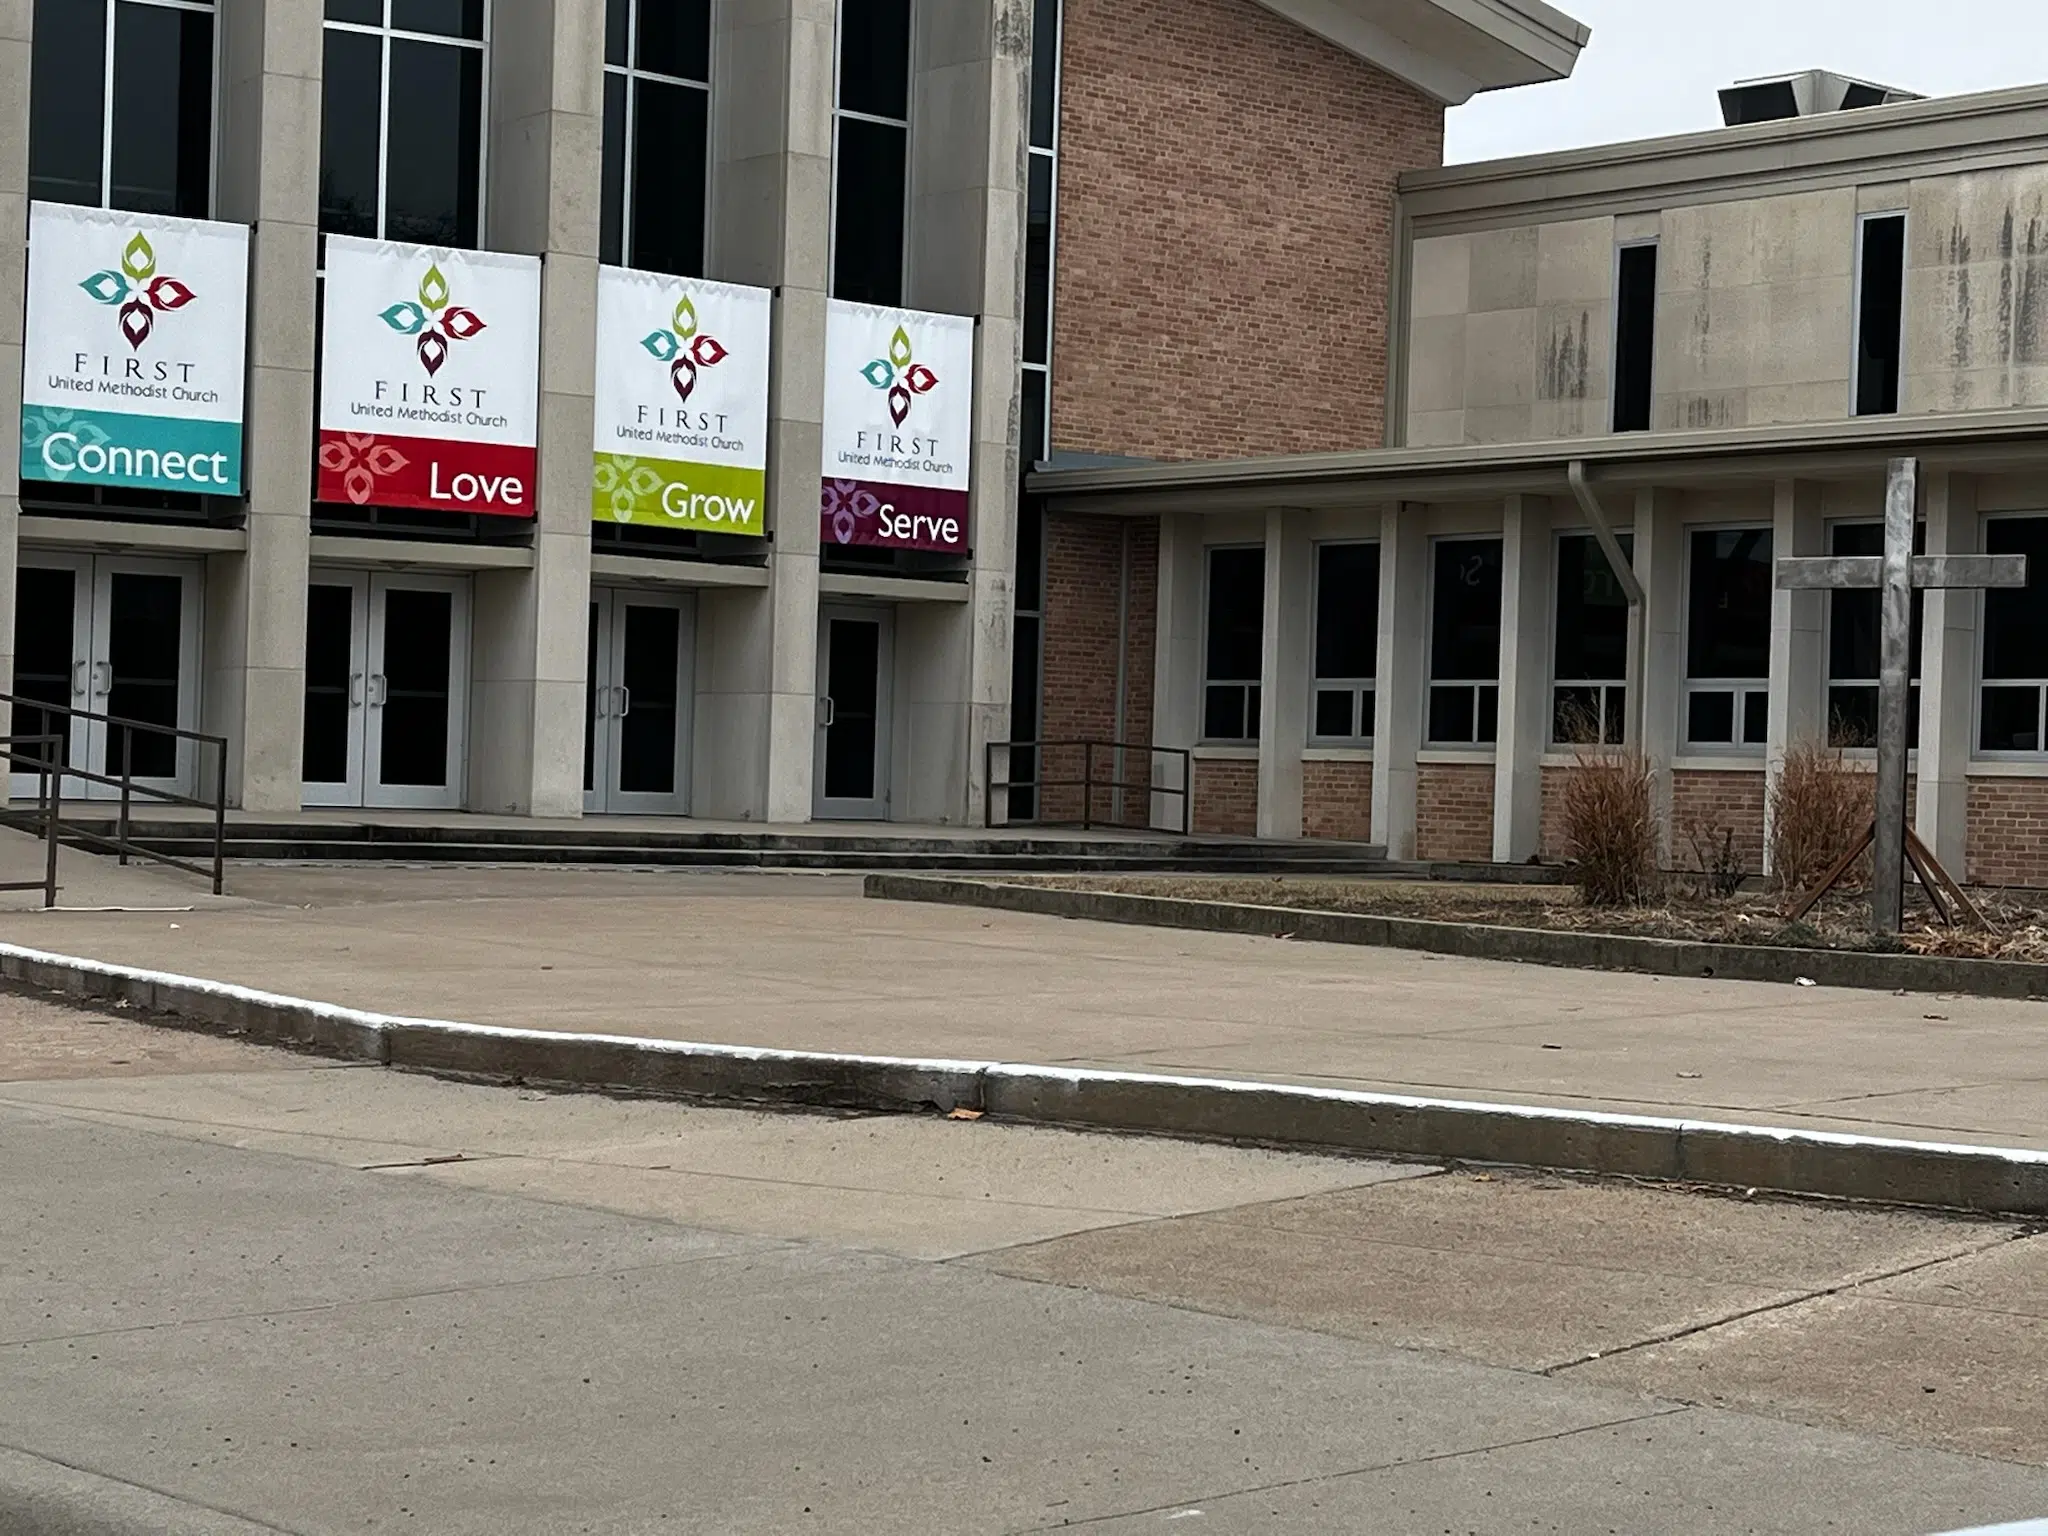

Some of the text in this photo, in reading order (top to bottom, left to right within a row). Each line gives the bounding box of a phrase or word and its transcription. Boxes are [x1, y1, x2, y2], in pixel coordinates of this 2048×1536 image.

[75, 353, 195, 383] FIRST
[49, 375, 218, 402] United Methodist Church
[375, 380, 486, 408] FIRST
[351, 402, 508, 427] United Methodist Church
[637, 405, 728, 433] FIRST
[617, 426, 744, 451] United Methodist Church
[857, 431, 939, 456] FIRST
[42, 431, 228, 484] Connect
[838, 451, 953, 473] United Methodist Church
[430, 461, 523, 505] Love
[662, 482, 755, 524] Grow
[878, 503, 959, 543] Serve
